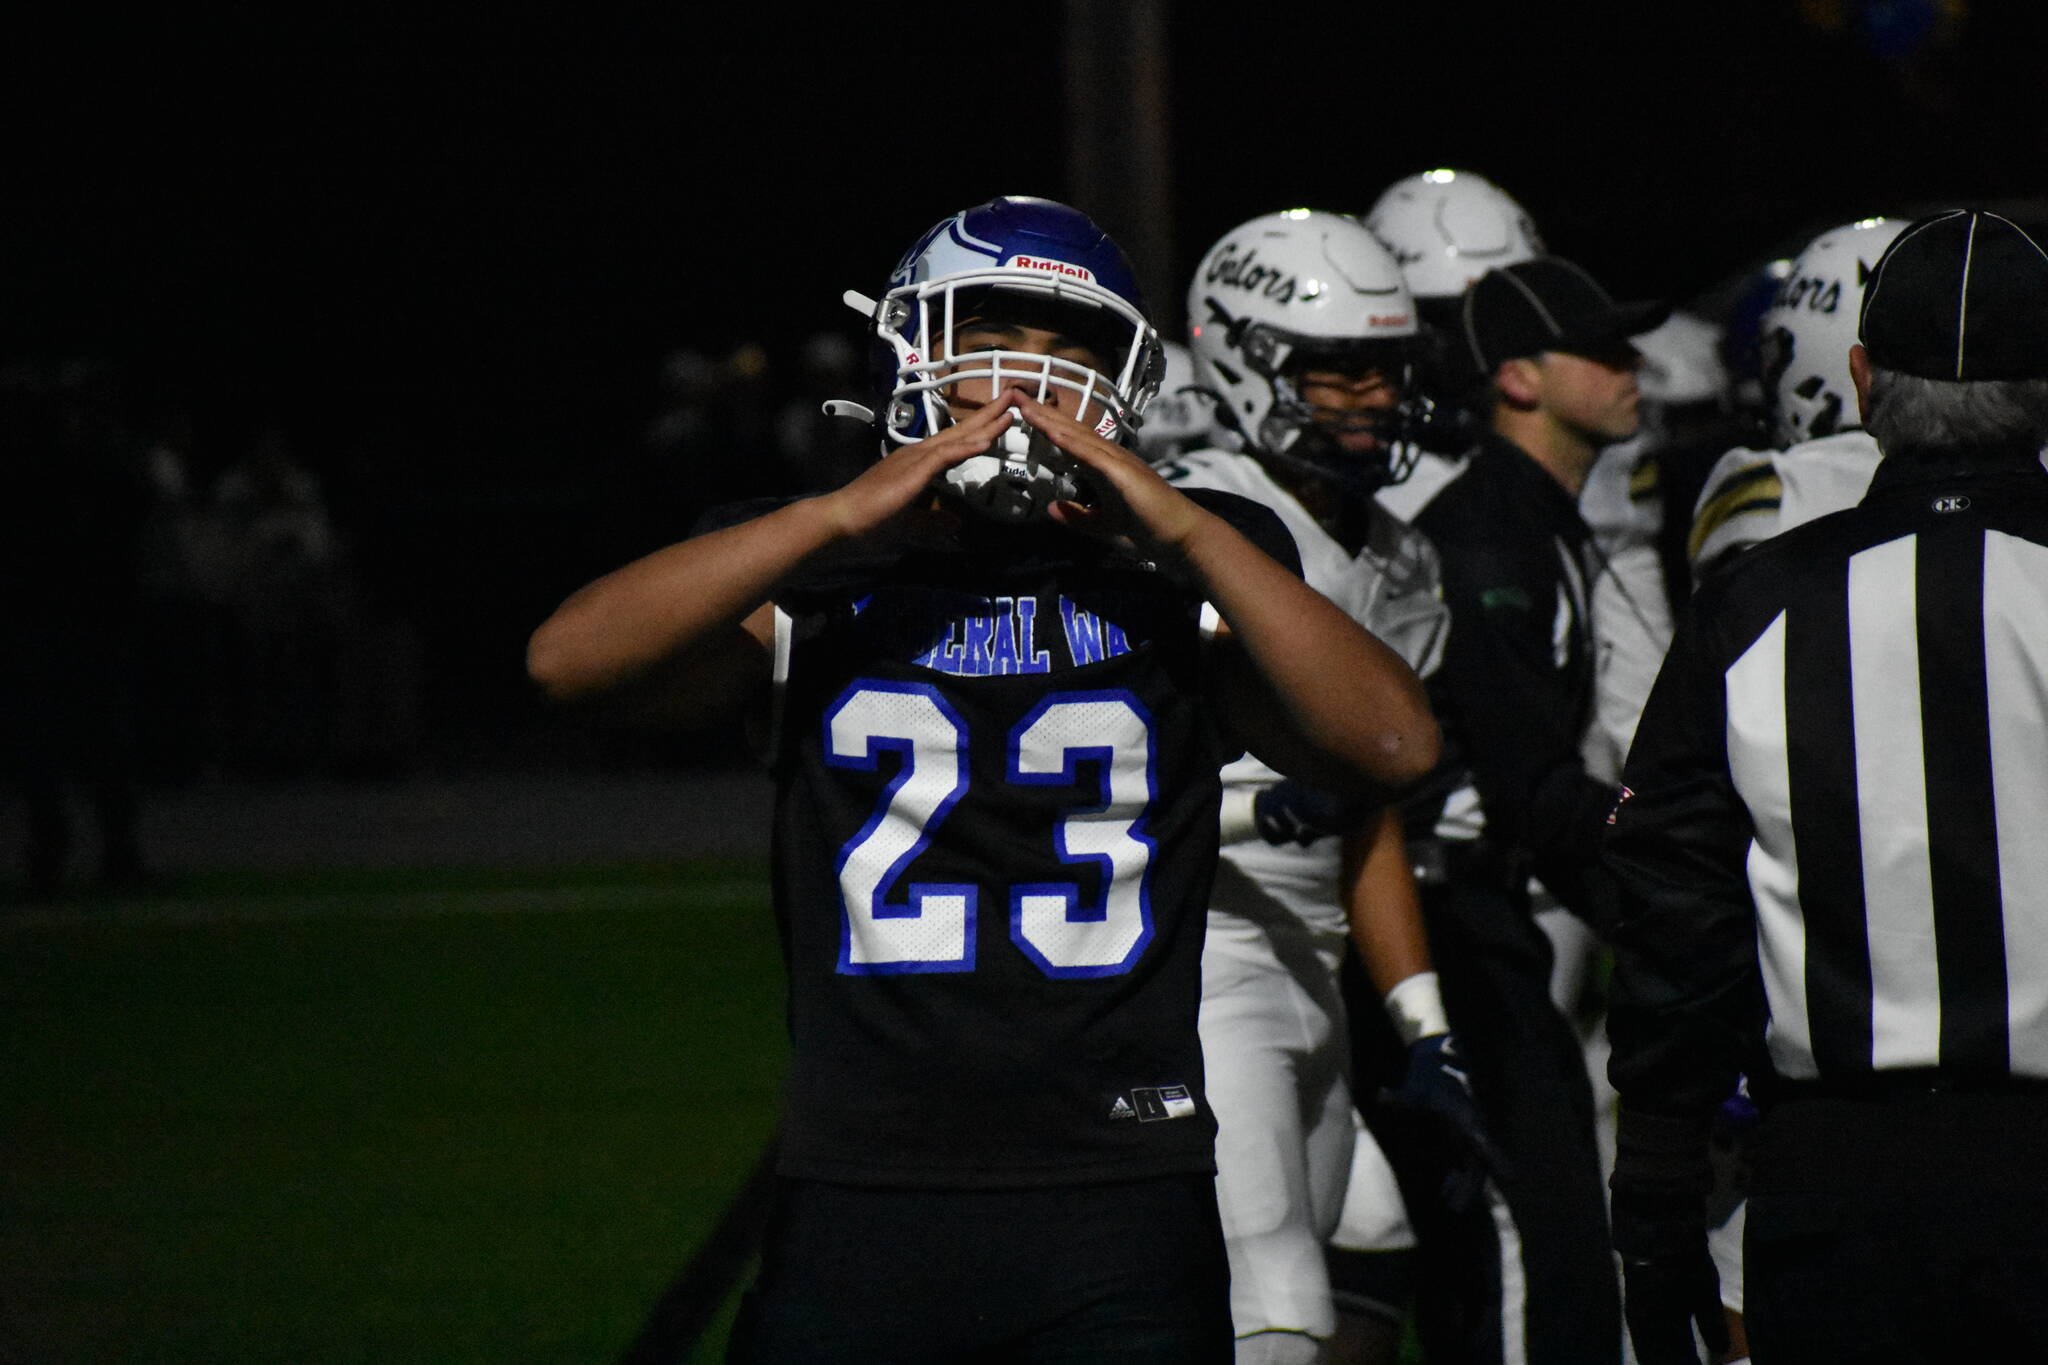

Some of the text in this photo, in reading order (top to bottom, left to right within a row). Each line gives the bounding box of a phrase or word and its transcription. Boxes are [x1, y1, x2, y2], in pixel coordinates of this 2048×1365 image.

[1016, 255, 1089, 281] Riddell
[1002, 466, 1026, 476] Ridd
[911, 594, 1133, 677] ERAL WA
[823, 677, 1158, 979] 23
